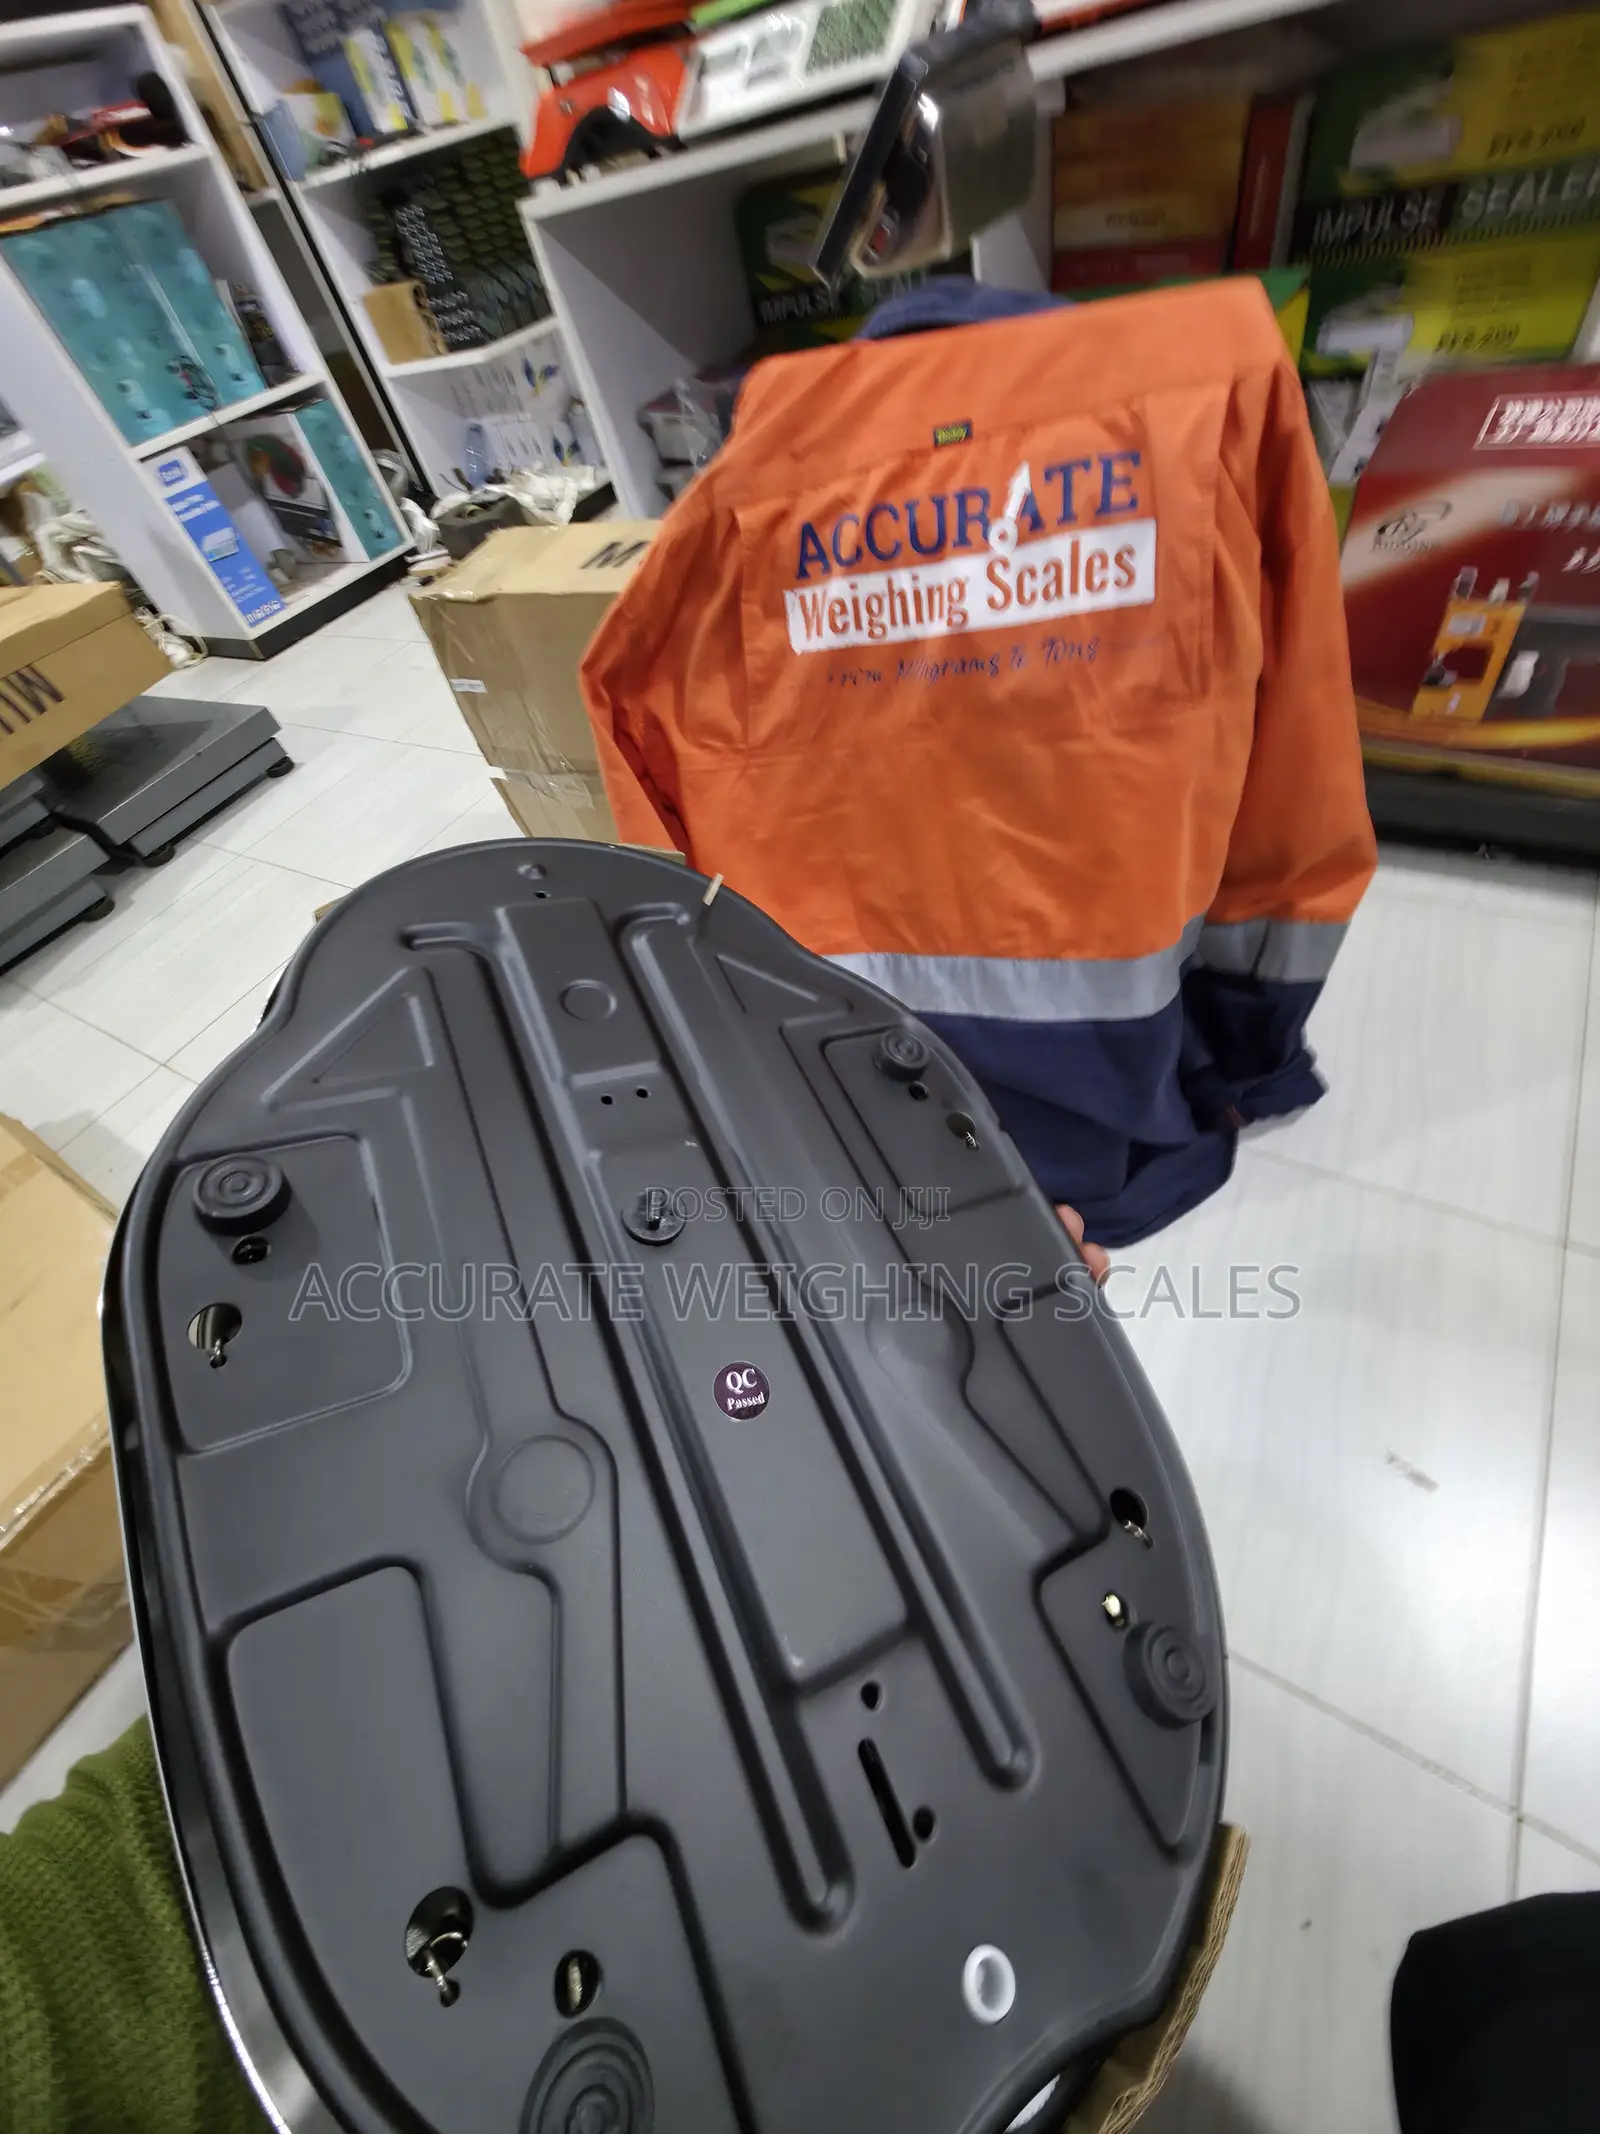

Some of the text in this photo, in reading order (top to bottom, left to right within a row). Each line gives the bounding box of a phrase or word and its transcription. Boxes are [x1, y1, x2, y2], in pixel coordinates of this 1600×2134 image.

[1311, 186, 1445, 247] IMPULSE
[759, 289, 835, 324] IMPULS
[795, 452, 1142, 580] ACCURATE
[797, 538, 1137, 642] Weighing Scales
[726, 1367, 757, 1395] QC
[726, 1391, 766, 1411] Passed
